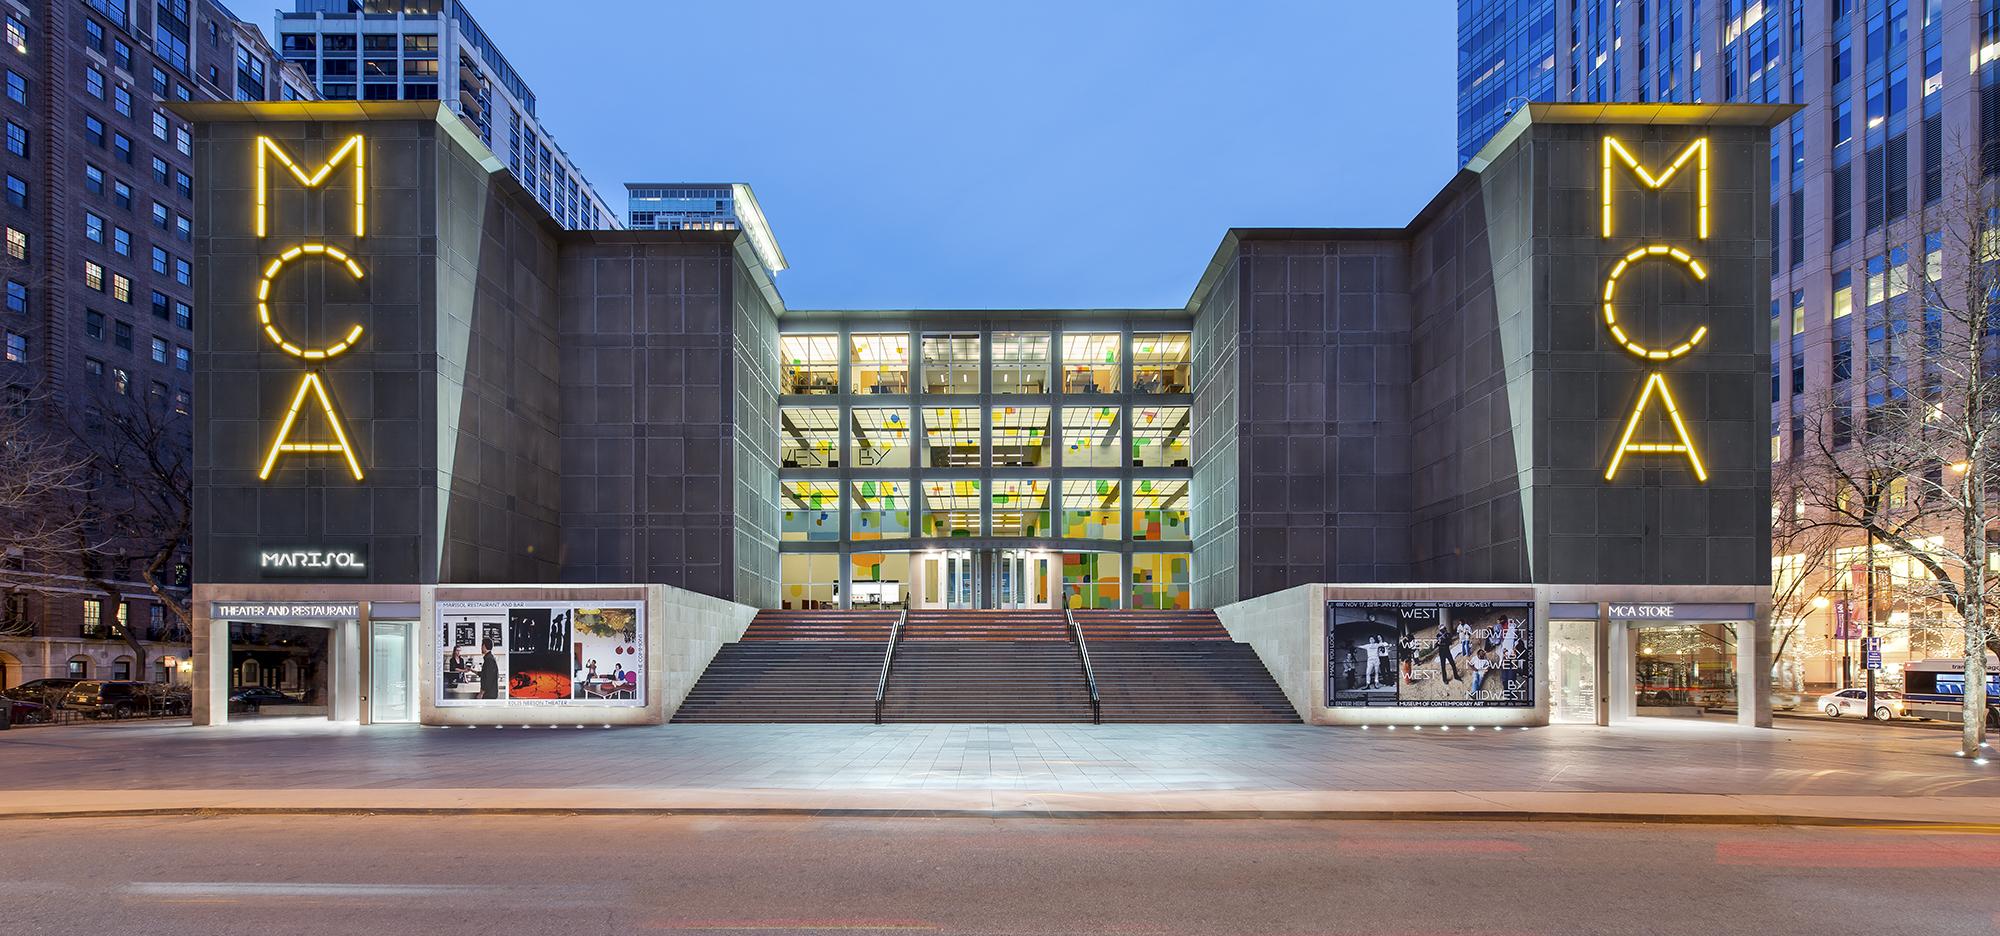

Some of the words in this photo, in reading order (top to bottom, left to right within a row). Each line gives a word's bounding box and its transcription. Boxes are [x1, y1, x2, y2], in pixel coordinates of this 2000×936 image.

[257, 135, 364, 480] MCA
[1603, 137, 1707, 481] MCA
[859, 448, 891, 466] BY
[261, 552, 364, 567] MARISOL
[220, 606, 264, 616] THEATER
[266, 606, 289, 616] AND
[291, 606, 359, 616] RESTAURANT
[1401, 608, 1437, 618] WEST
[1608, 605, 1636, 617] MCA
[1638, 605, 1674, 617] STORE
[1466, 629, 1525, 638] MIDWEST
[1401, 639, 1437, 649] WEST
[1869, 638, 1880, 651] H
[1401, 669, 1437, 679] WEST
[1508, 680, 1525, 689] BY
[1465, 690, 1526, 700] MIDWEST
